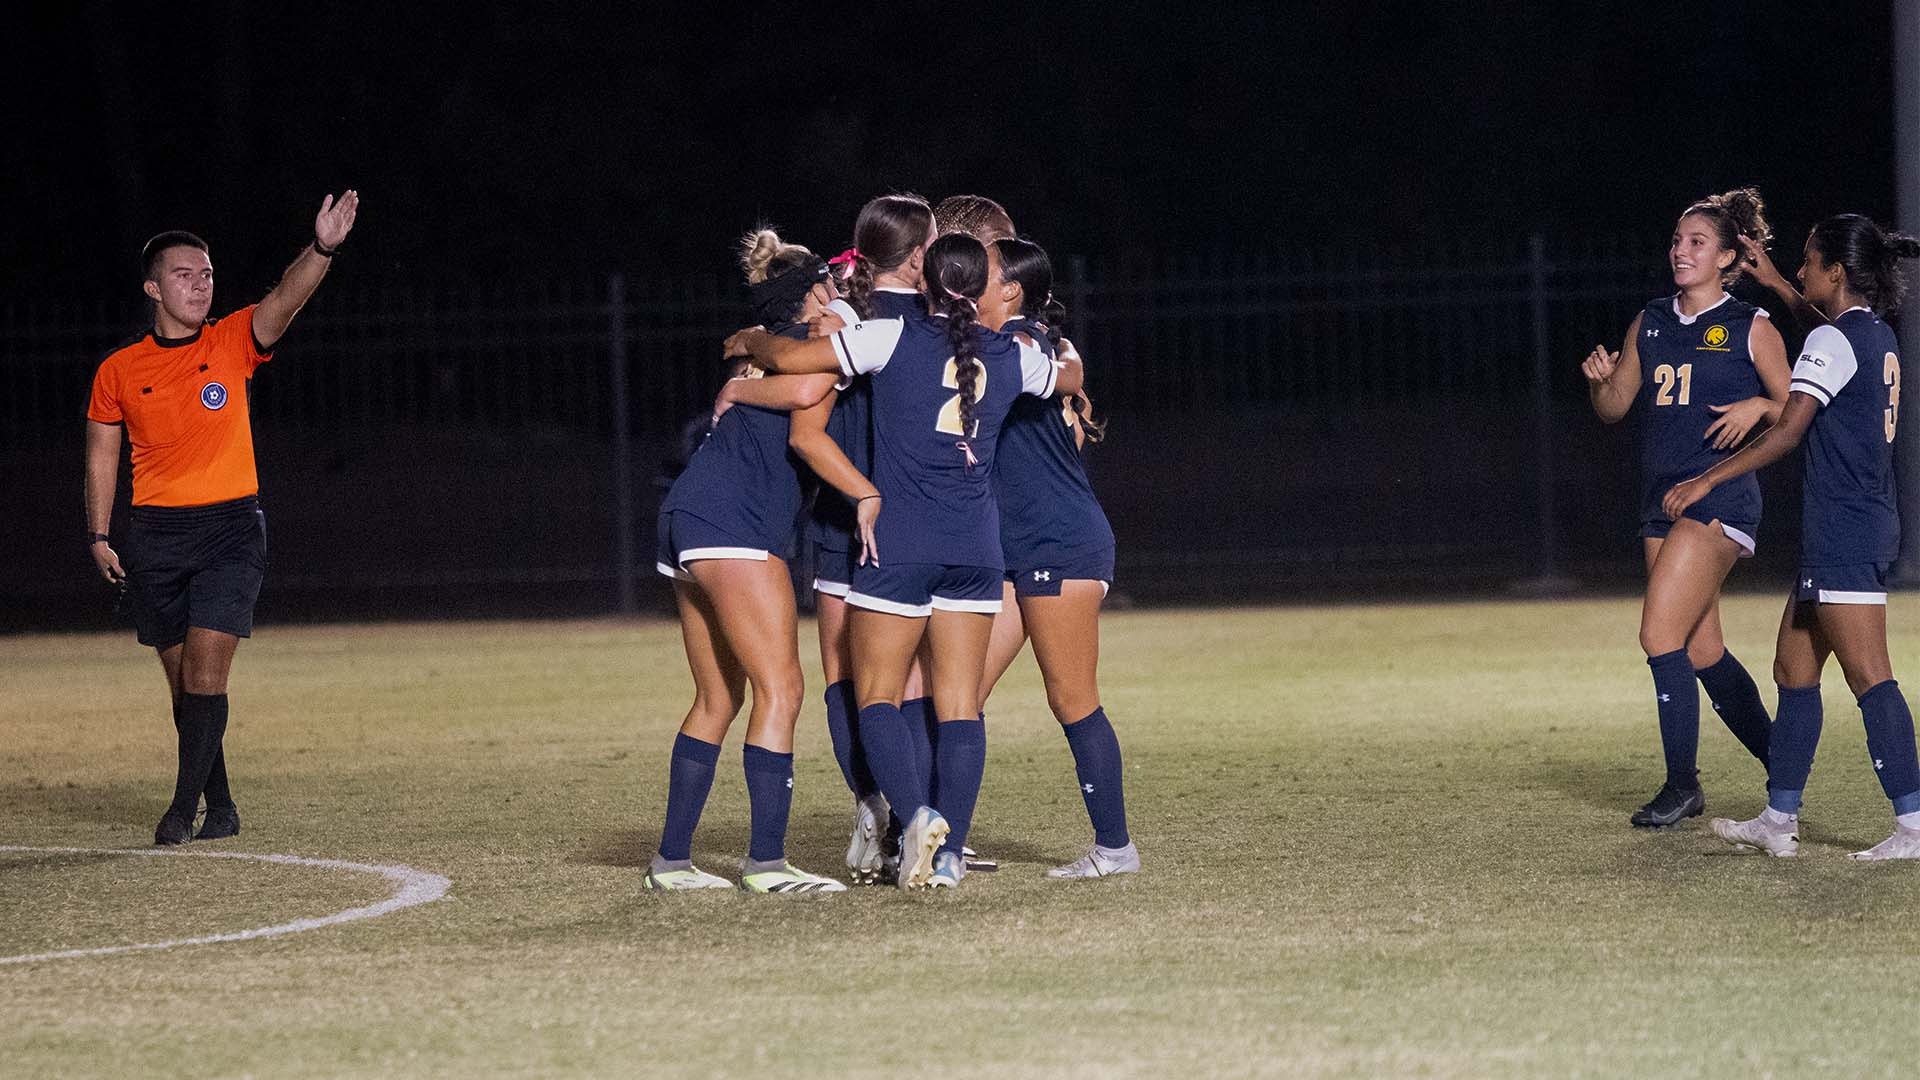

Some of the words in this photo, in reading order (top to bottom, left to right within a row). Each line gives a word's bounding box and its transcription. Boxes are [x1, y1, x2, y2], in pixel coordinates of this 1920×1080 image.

[1654, 364, 1692, 406] 21
[1800, 354, 1825, 367] SLC
[936, 356, 987, 438] 2
[1884, 352, 1901, 443] 3
